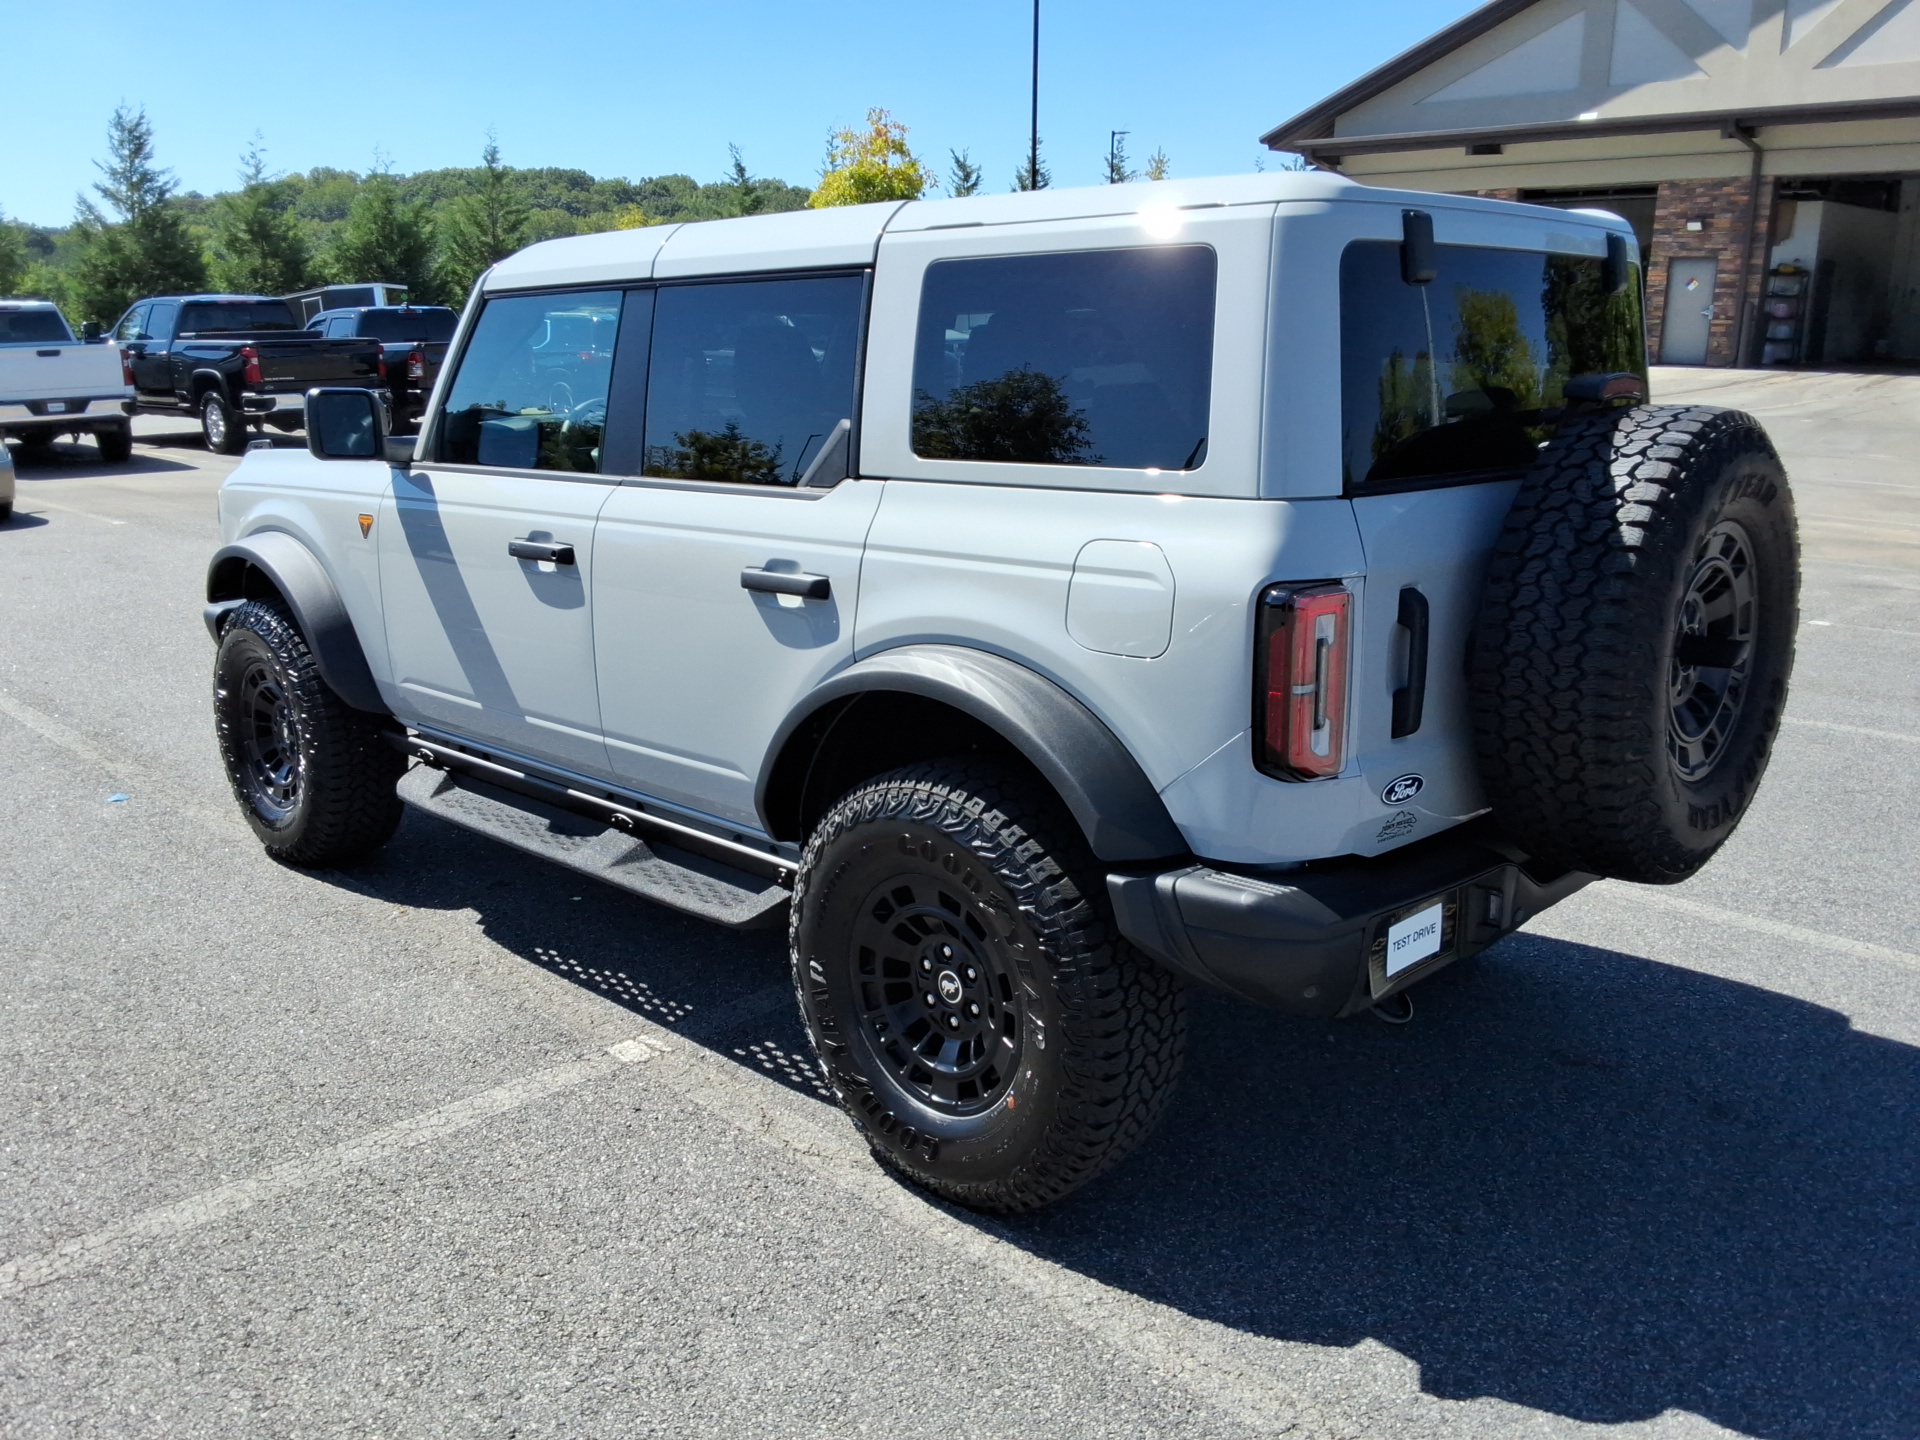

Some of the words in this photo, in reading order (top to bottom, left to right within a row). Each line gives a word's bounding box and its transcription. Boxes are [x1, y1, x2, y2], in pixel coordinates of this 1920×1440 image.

[1390, 779, 1419, 801] Ford
[1392, 933, 1412, 952] TEST
[1413, 922, 1436, 942] DRIVE
